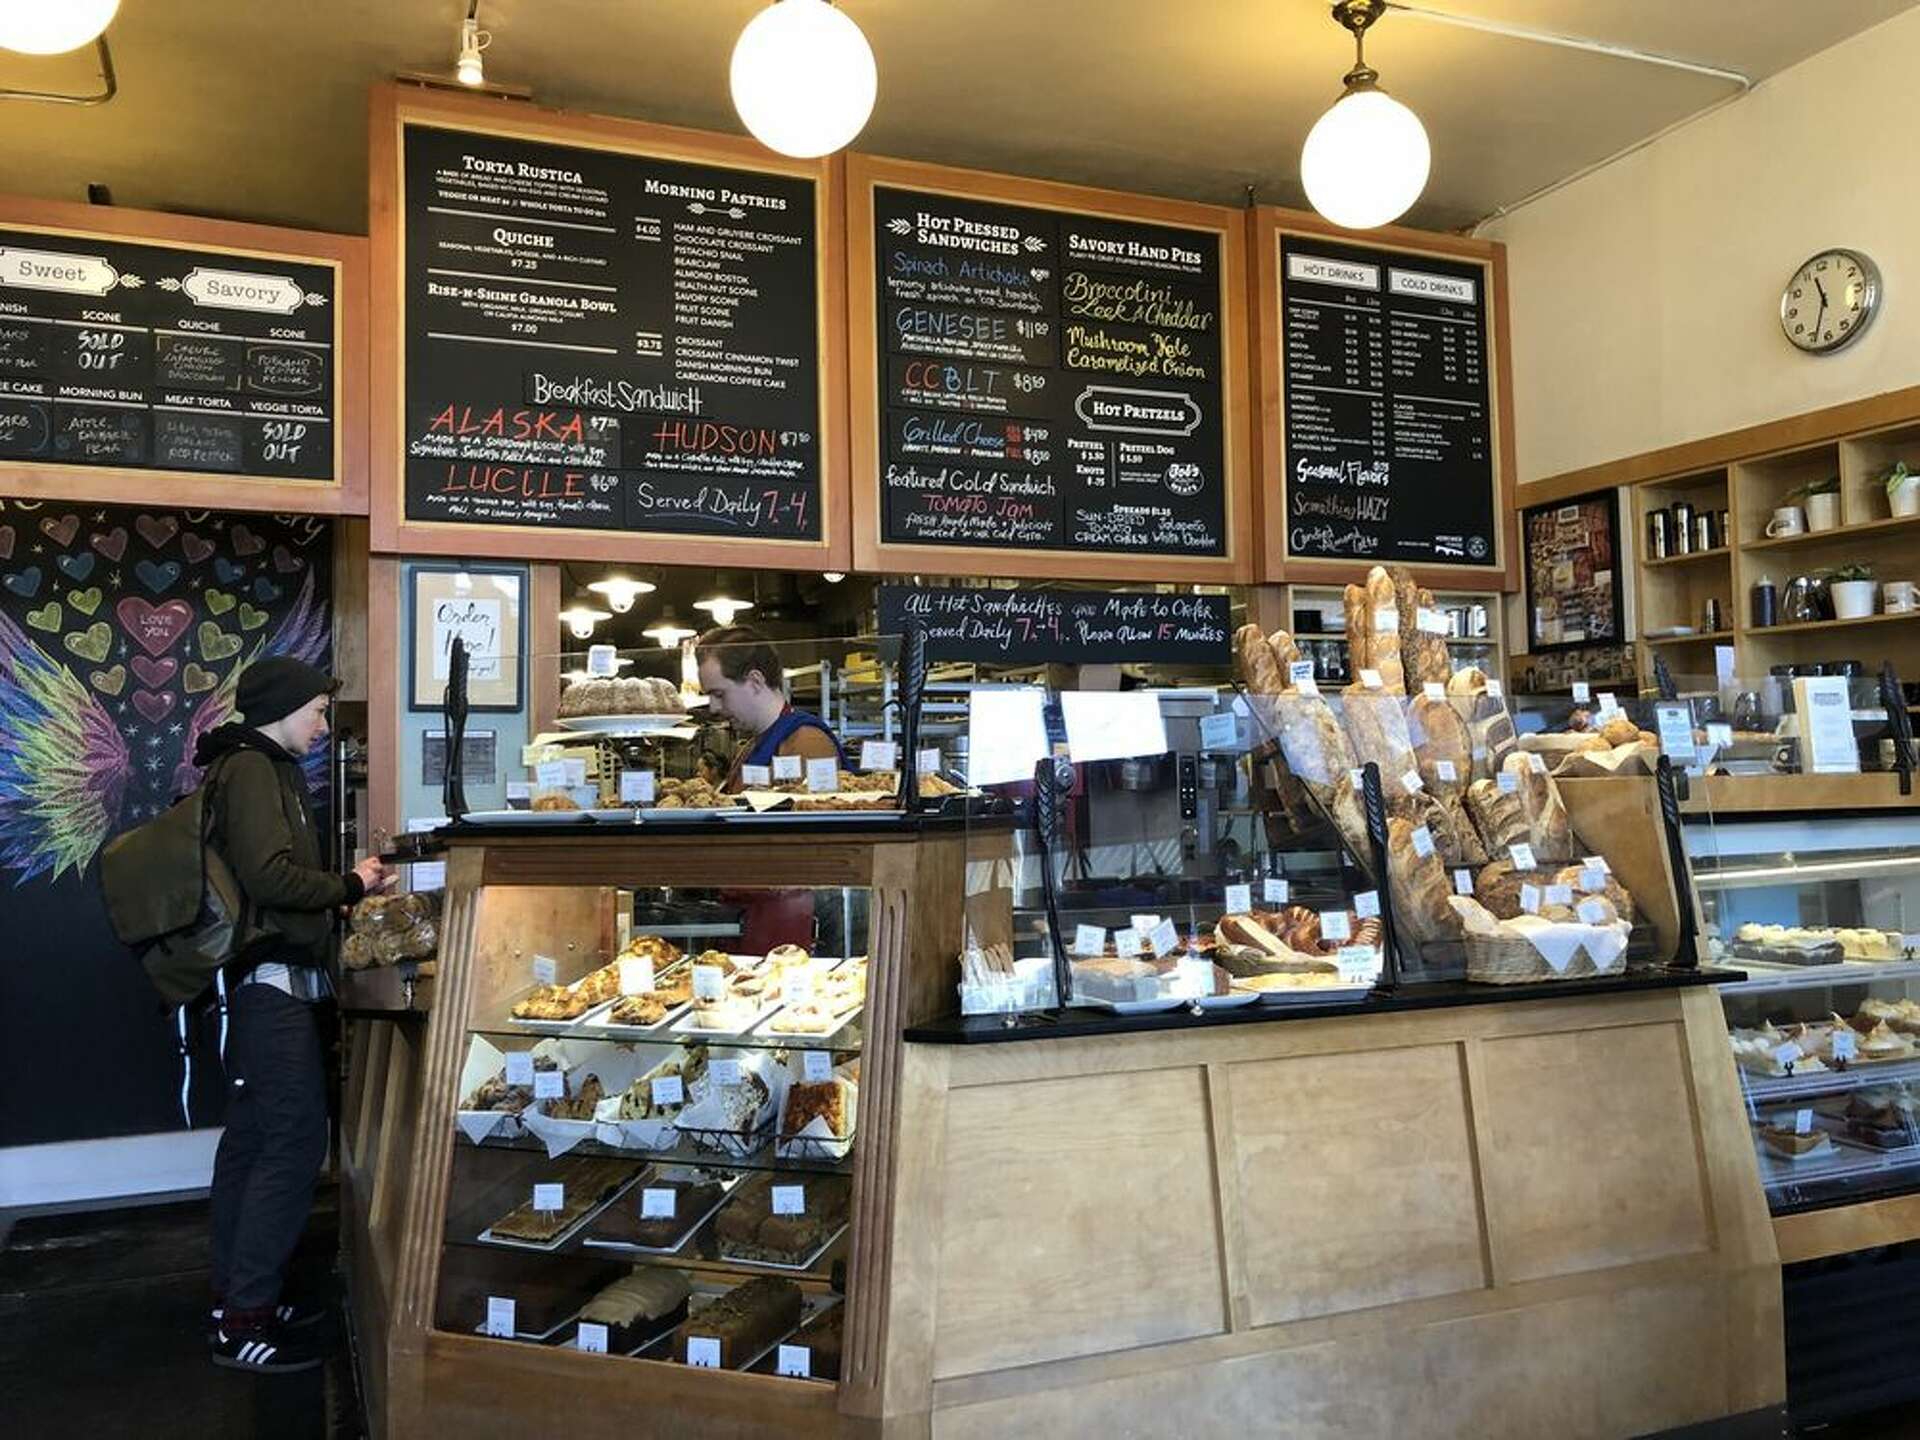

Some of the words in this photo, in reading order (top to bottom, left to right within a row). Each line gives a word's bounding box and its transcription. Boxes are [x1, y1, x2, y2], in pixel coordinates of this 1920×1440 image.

[462, 155, 514, 176] TORTA
[518, 163, 582, 184] RUSTICA
[645, 180, 715, 200] MORNING
[721, 189, 786, 210] PASTRIES
[697, 226, 715, 234] AND
[756, 233, 802, 245] CROISSANT
[917, 213, 951, 230] HOT
[954, 218, 1020, 240] PRESSED
[493, 228, 554, 248] QUICHE
[674, 234, 725, 248] CHOCOLATE
[728, 240, 774, 253] CROISSANT
[917, 229, 1019, 256] SANDWICHES
[1069, 234, 1125, 256] SAVORY
[1128, 242, 1169, 260] HAND
[1171, 247, 1201, 264] PIES
[18, 261, 87, 282] Sweet
[894, 251, 949, 277] Spinach
[1816, 260, 1828, 272] 12
[1837, 260, 1840, 270] 1
[1847, 267, 1856, 277] 2
[1303, 265, 1325, 276] HOT
[1329, 268, 1364, 282] DRINKS
[206, 280, 281, 305] Savory
[1401, 278, 1427, 290] COLD
[1430, 282, 1464, 296] DRINKS
[1792, 289, 1802, 299] 10
[1854, 282, 1863, 293] 3
[520, 292, 578, 309] GRANOLA
[581, 298, 617, 312] BOWL
[675, 304, 698, 313] FRUIT
[700, 306, 730, 317] SCONE
[1851, 302, 1860, 312] 4
[82, 310, 121, 323] SCONE
[675, 315, 698, 325] FRUIT
[700, 317, 734, 328] DANISH
[1789, 308, 1798, 319] 9
[178, 319, 220, 331] QUICHE
[270, 328, 306, 339] SCONE
[896, 307, 1008, 342] GENESEE
[1795, 323, 1804, 334] 8
[1839, 319, 1849, 331] 5
[78, 330, 124, 350] SOLD
[675, 336, 724, 348] CROISSANT
[1066, 326, 1150, 357] Mushroom
[1824, 330, 1833, 341] 6
[78, 352, 124, 369] OUT
[675, 348, 724, 360] CROISSANT
[675, 359, 709, 370] DANISH
[755, 367, 772, 376] BUN
[1163, 358, 1205, 379] Onion
[13, 383, 44, 394] CAKE
[730, 376, 762, 387] COFFEE
[764, 380, 786, 389] CAKE
[59, 387, 116, 399] MORNING
[119, 390, 143, 400] BUN
[534, 374, 616, 410] Breakfast
[165, 395, 195, 405] MEAT
[198, 397, 232, 408] TORTA
[250, 401, 289, 413] VEGGIE
[292, 404, 323, 415] TORTA
[1093, 402, 1121, 417] HOT
[1124, 404, 1185, 421] PRETZELS
[430, 401, 585, 442] ALASKA
[262, 422, 306, 442] SOLD
[652, 420, 776, 455] HUDSON
[262, 443, 301, 463] OUT
[1067, 438, 1104, 450] PRETZEL
[1120, 443, 1156, 454] PRETZEL
[1157, 445, 1175, 455] DOG
[1076, 464, 1105, 476] KNOTS
[885, 463, 948, 490] featured
[950, 470, 998, 494] Cold
[1000, 472, 1056, 496] Sandwich
[638, 482, 708, 510] Served
[710, 488, 761, 527] Daily
[1357, 496, 1390, 521] HAZY
[438, 602, 490, 626] Order
[935, 597, 970, 613] Hot
[1104, 598, 1148, 619] Made
[1150, 598, 1168, 616] to
[969, 619, 1012, 649] Daily
[1157, 623, 1174, 640] 15
